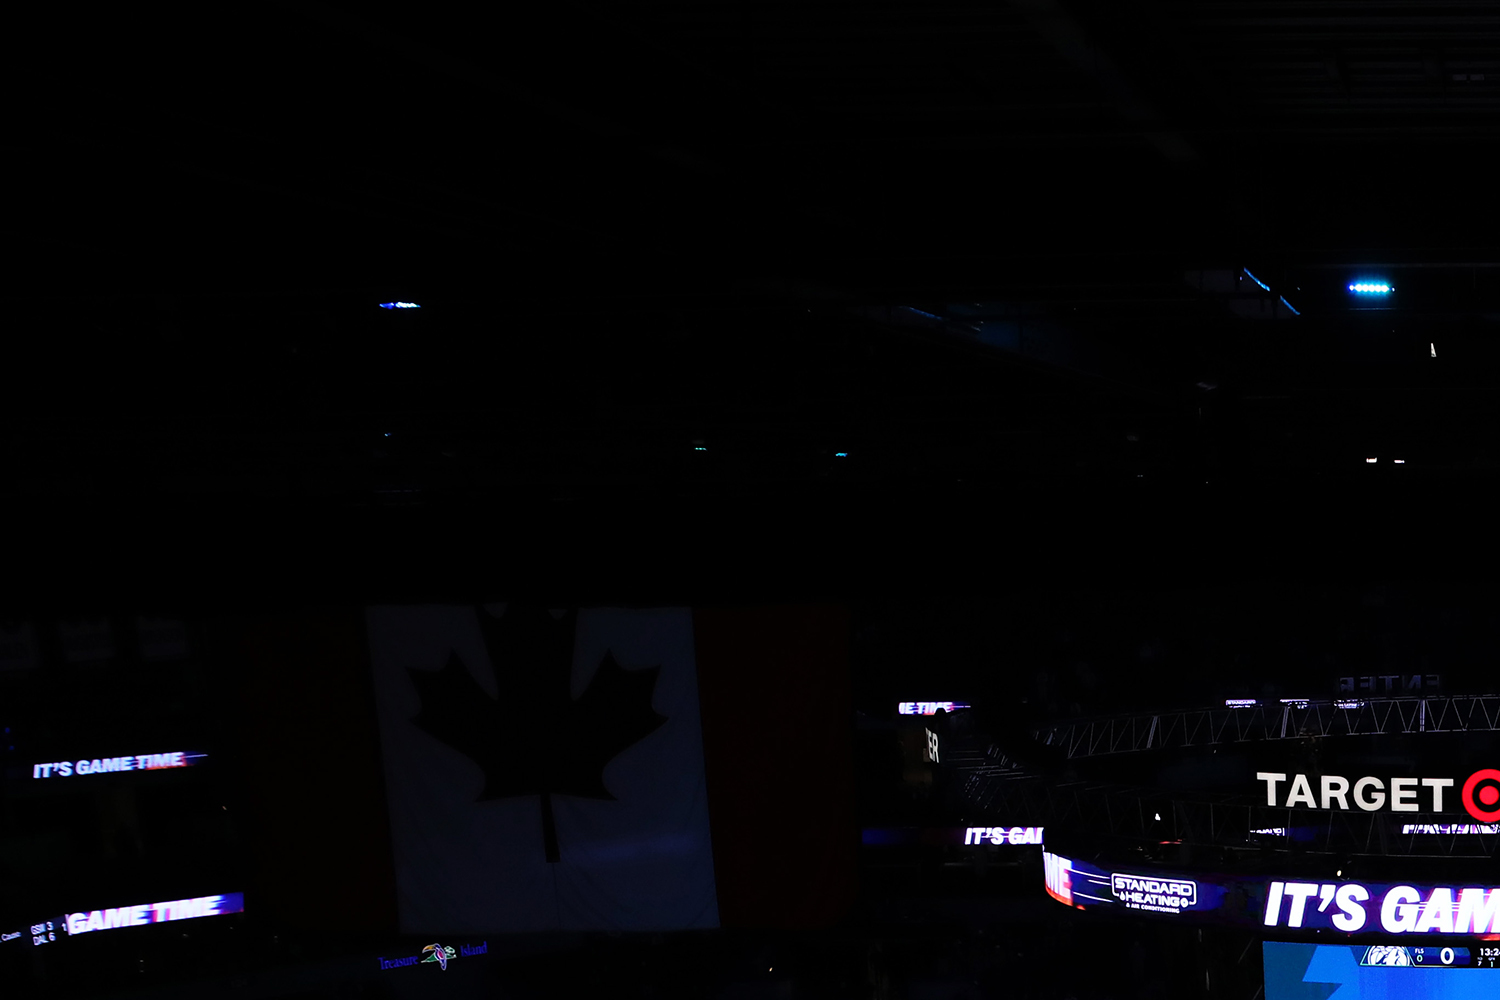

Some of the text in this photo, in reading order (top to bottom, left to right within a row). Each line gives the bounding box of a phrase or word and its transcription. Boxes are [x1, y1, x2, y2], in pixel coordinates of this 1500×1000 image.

[33, 751, 184, 779] IT'S GAME TIME
[1257, 772, 1454, 812] TARGET
[964, 827, 1005, 845] IT'S
[1115, 878, 1193, 897] STANDARD
[1125, 891, 1180, 908] HEATING
[68, 894, 222, 936] GAME TIME
[1264, 881, 1370, 932] IT'S
[378, 940, 488, 970] Treasure Island
[1440, 947, 1454, 965] 0
